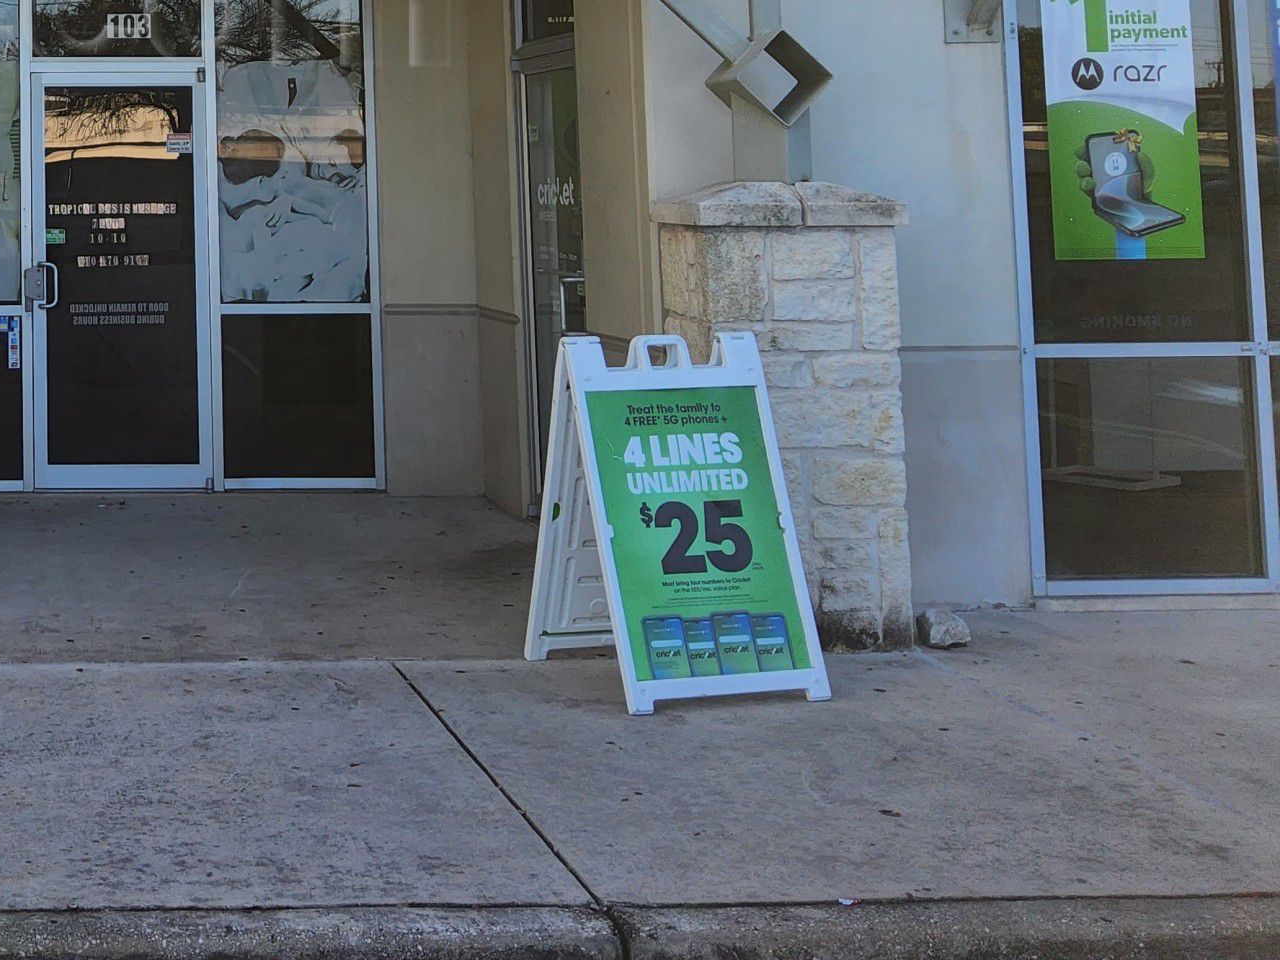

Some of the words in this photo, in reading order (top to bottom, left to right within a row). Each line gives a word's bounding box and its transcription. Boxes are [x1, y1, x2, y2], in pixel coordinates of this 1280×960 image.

[110, 14, 150, 38] 103
[1109, 10, 1157, 25] initial
[1110, 25, 1188, 43] payment
[1114, 65, 1167, 82] razr
[626, 404, 654, 415] Treat
[656, 404, 673, 414] the
[675, 403, 709, 415] family
[711, 402, 721, 413] to
[624, 417, 631, 426] 4
[663, 415, 679, 425] 5G
[681, 414, 719, 426] phones
[624, 436, 646, 467] 4
[649, 432, 743, 466] LINES
[627, 468, 749, 495] UNLIMITED
[640, 499, 753, 575] $25
